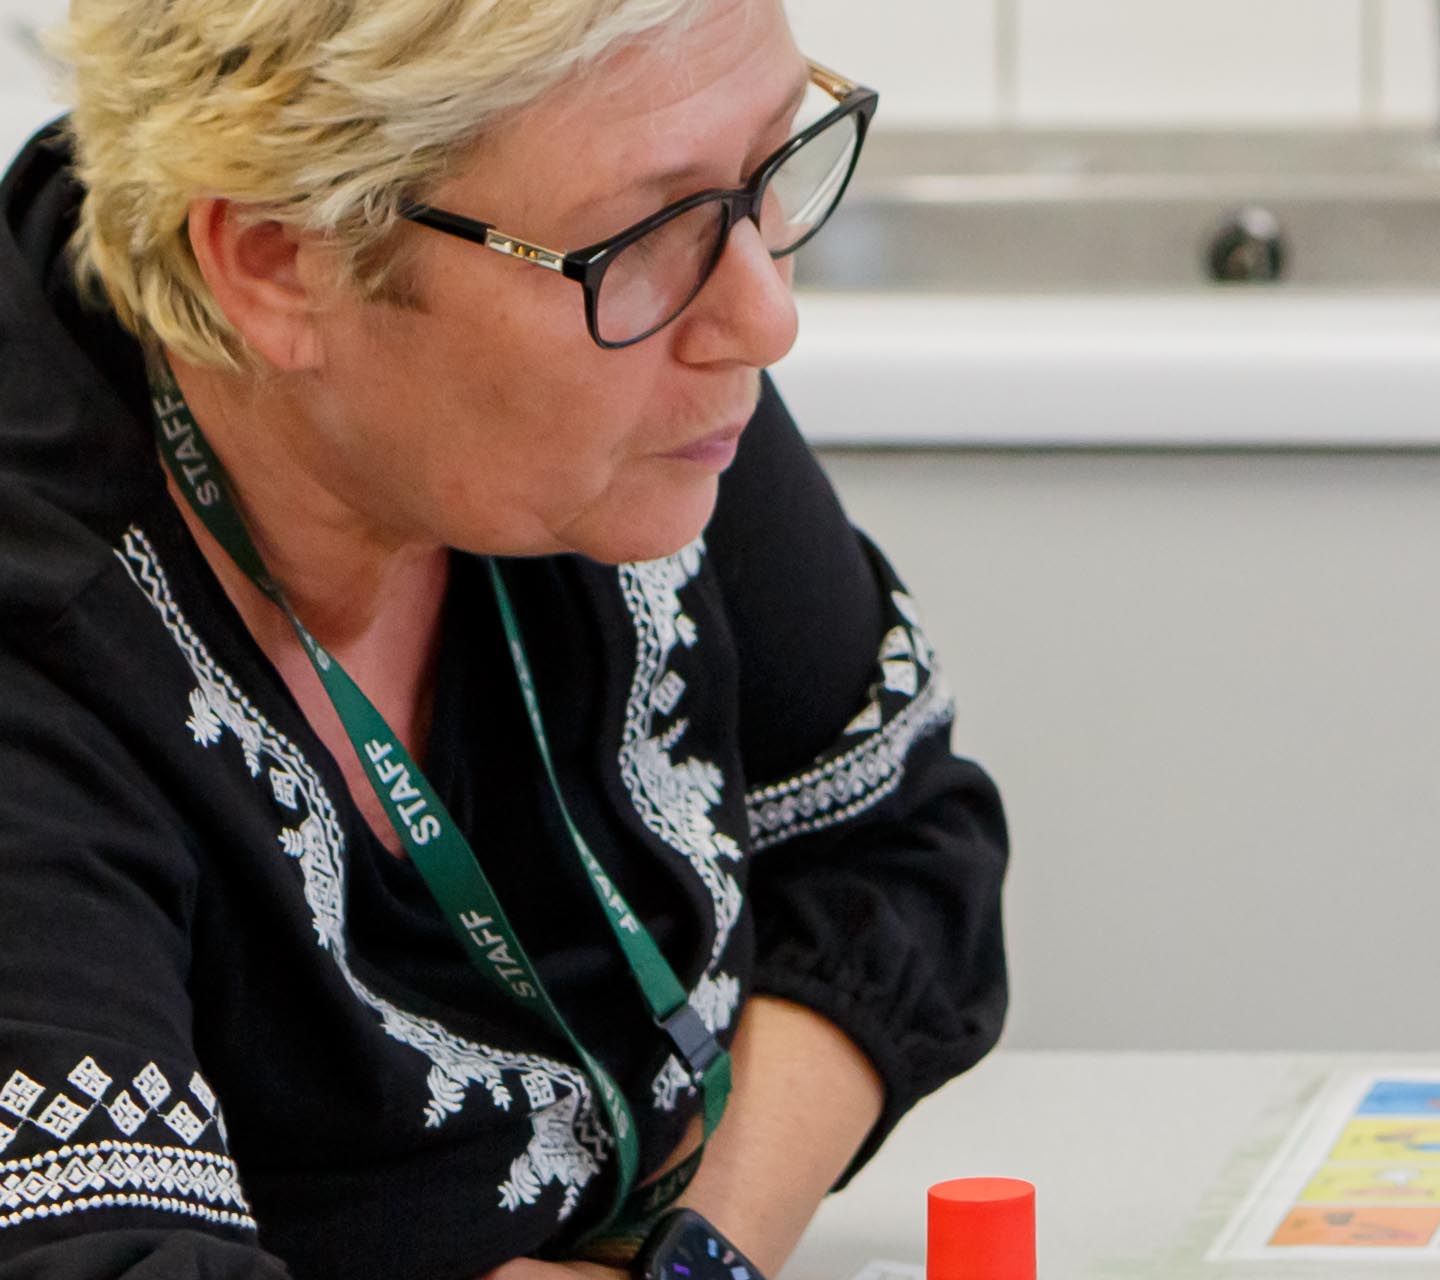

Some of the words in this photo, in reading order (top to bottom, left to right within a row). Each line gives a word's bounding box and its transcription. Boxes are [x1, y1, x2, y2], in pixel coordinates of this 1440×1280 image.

[152, 395, 221, 506] STAFF
[364, 738, 441, 846] STAFF
[459, 909, 537, 999] STAFF
